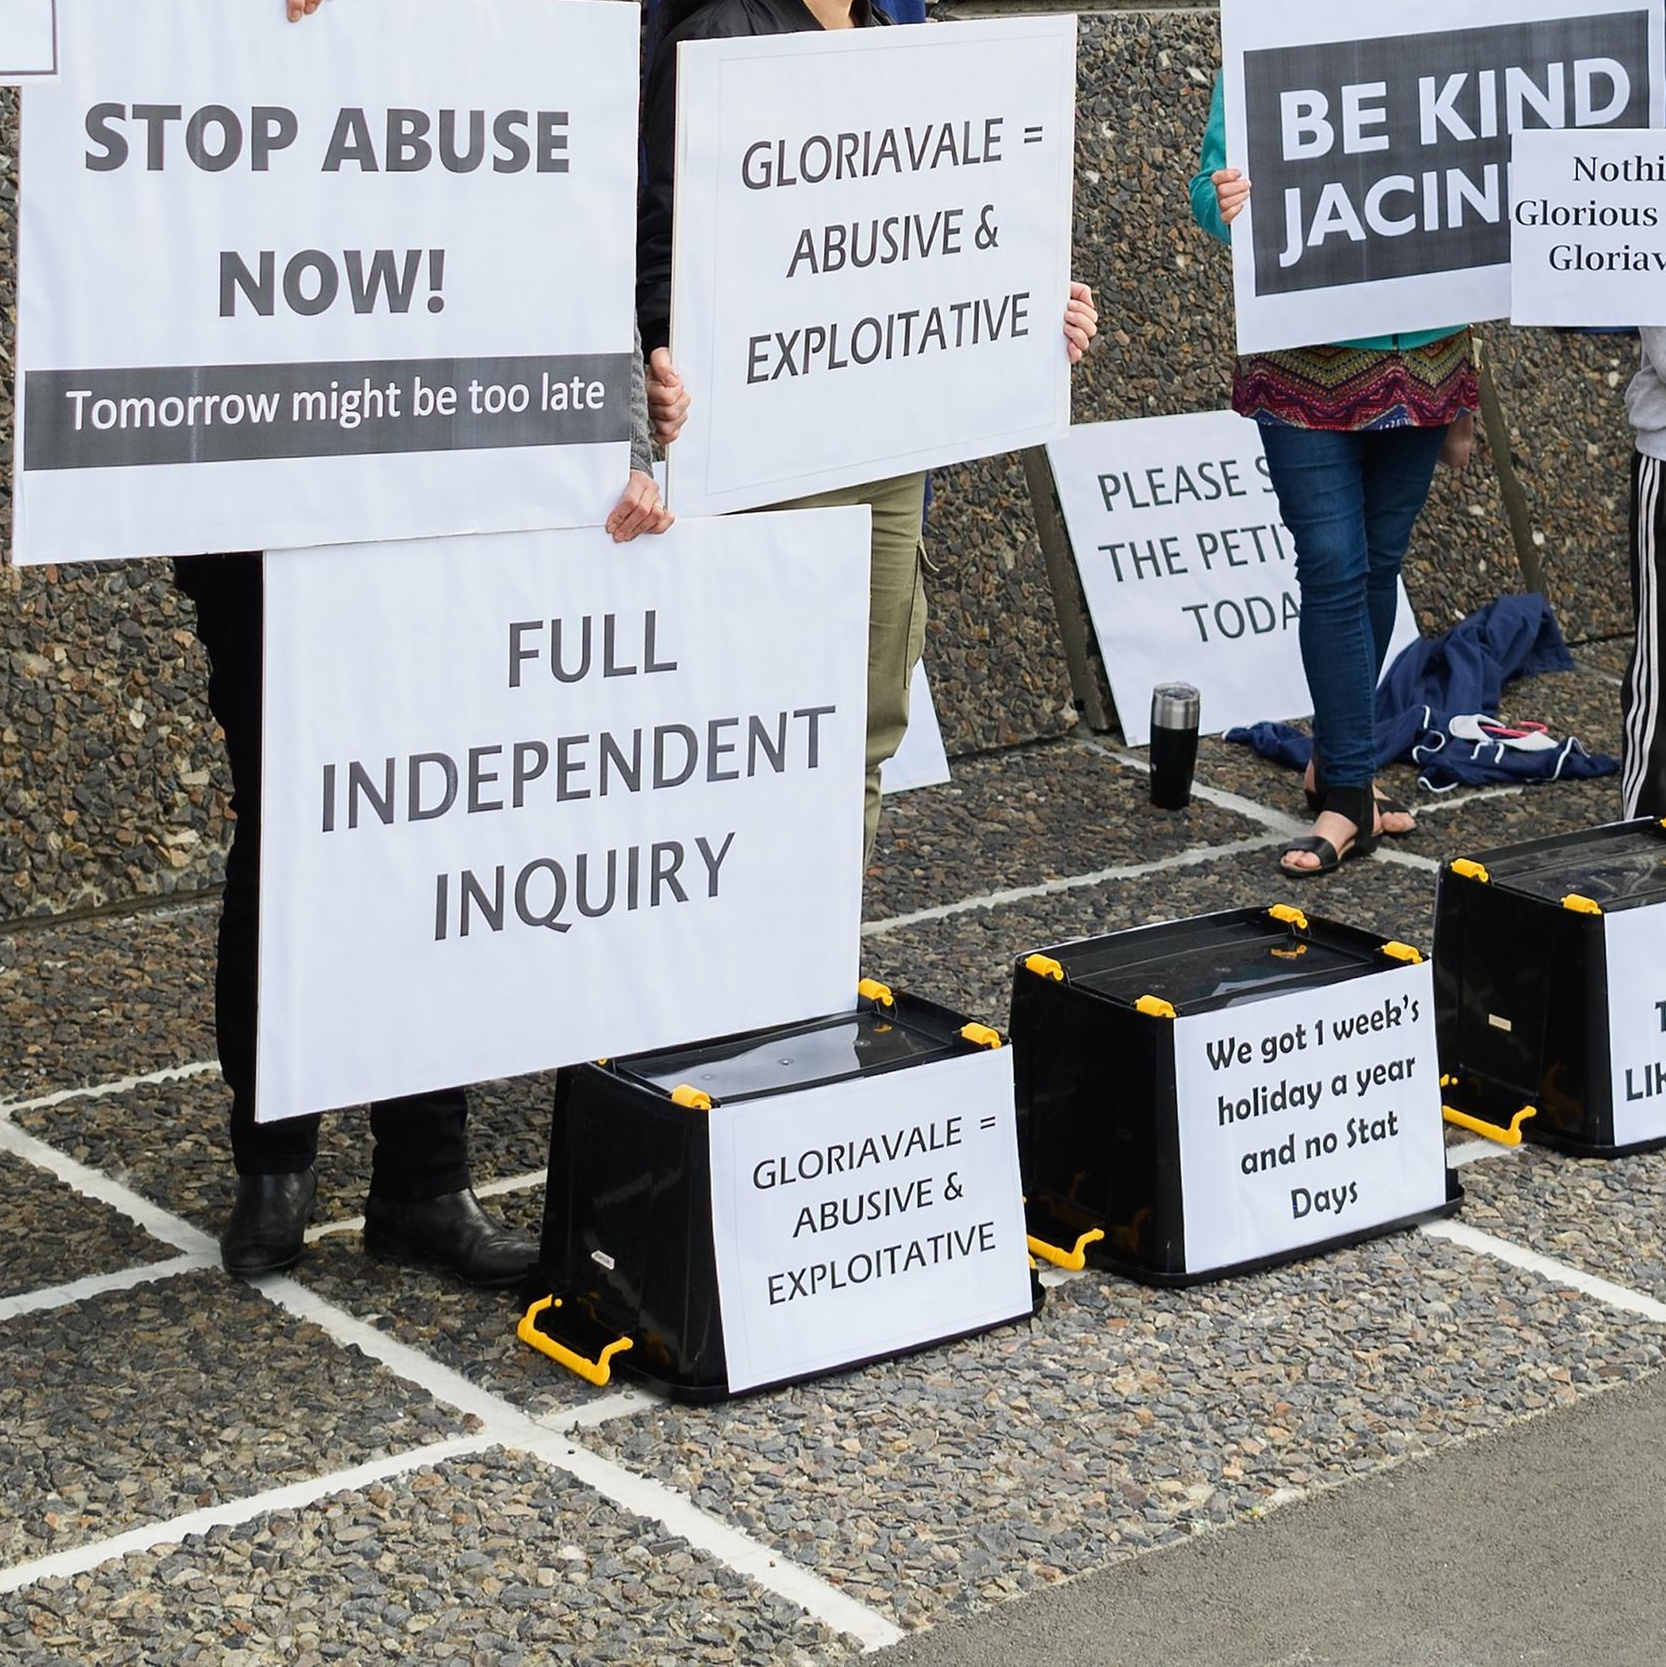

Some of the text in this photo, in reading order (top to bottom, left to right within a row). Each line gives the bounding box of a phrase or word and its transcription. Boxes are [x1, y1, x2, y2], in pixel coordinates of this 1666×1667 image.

[84, 102, 570, 174] STOP ABUSE
[1280, 57, 1630, 161] BE KIND
[741, 117, 1043, 191] GLORIAVALE =
[786, 204, 999, 278] ABUSIVE &
[1279, 162, 1511, 269] JACIN
[1514, 199, 1659, 229] Glorious
[218, 249, 446, 318] NOW!
[746, 292, 1030, 385] EXPLOITATIVE
[66, 372, 605, 430] Tomorrow might be too late
[1098, 460, 1246, 512] PLEASE
[1098, 523, 1288, 583] THE PETI
[508, 610, 678, 688] FULL
[1181, 591, 1301, 643] TODA
[321, 704, 836, 833] INDEPENDENT
[434, 832, 736, 942] INQUIRY
[1206, 1037, 1252, 1071] We
[1261, 1025, 1307, 1064] got
[1315, 1020, 1325, 1045] 1
[1218, 1057, 1415, 1126] holiday a year
[752, 1116, 996, 1190] GLORIAVALE =
[1241, 1111, 1399, 1175] and no Stat
[792, 1171, 964, 1238] ABUSIVE &
[1291, 1181, 1358, 1220] Days
[767, 1222, 996, 1306] EXPLOITATIVE
